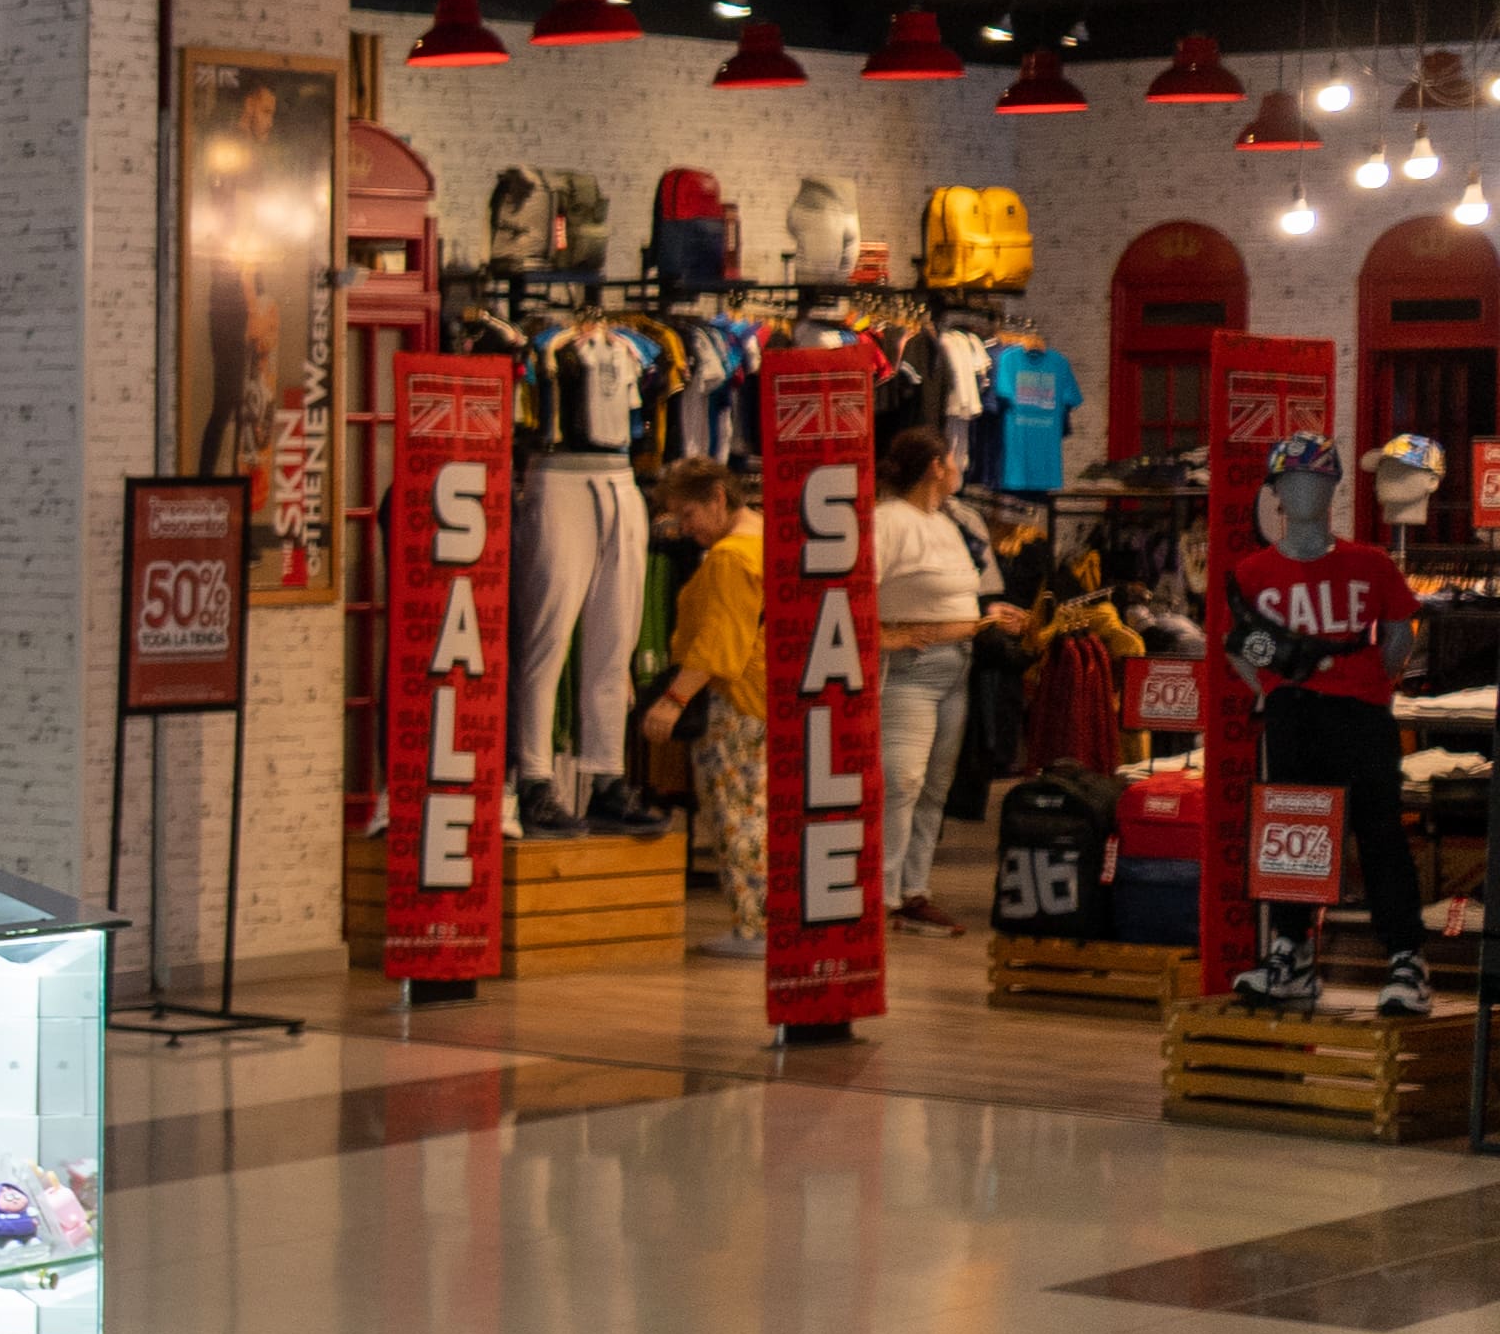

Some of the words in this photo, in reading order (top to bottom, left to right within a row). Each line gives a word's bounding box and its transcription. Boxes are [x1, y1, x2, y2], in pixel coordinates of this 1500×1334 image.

[275, 408, 302, 539] SKIN
[1485, 474, 1500, 498] 5
[145, 565, 228, 629] 50%
[1256, 579, 1371, 635] SALE
[420, 462, 488, 891] SALE
[800, 464, 864, 925] SALE
[1145, 681, 1199, 707] 50%
[1264, 827, 1332, 861] 50%
